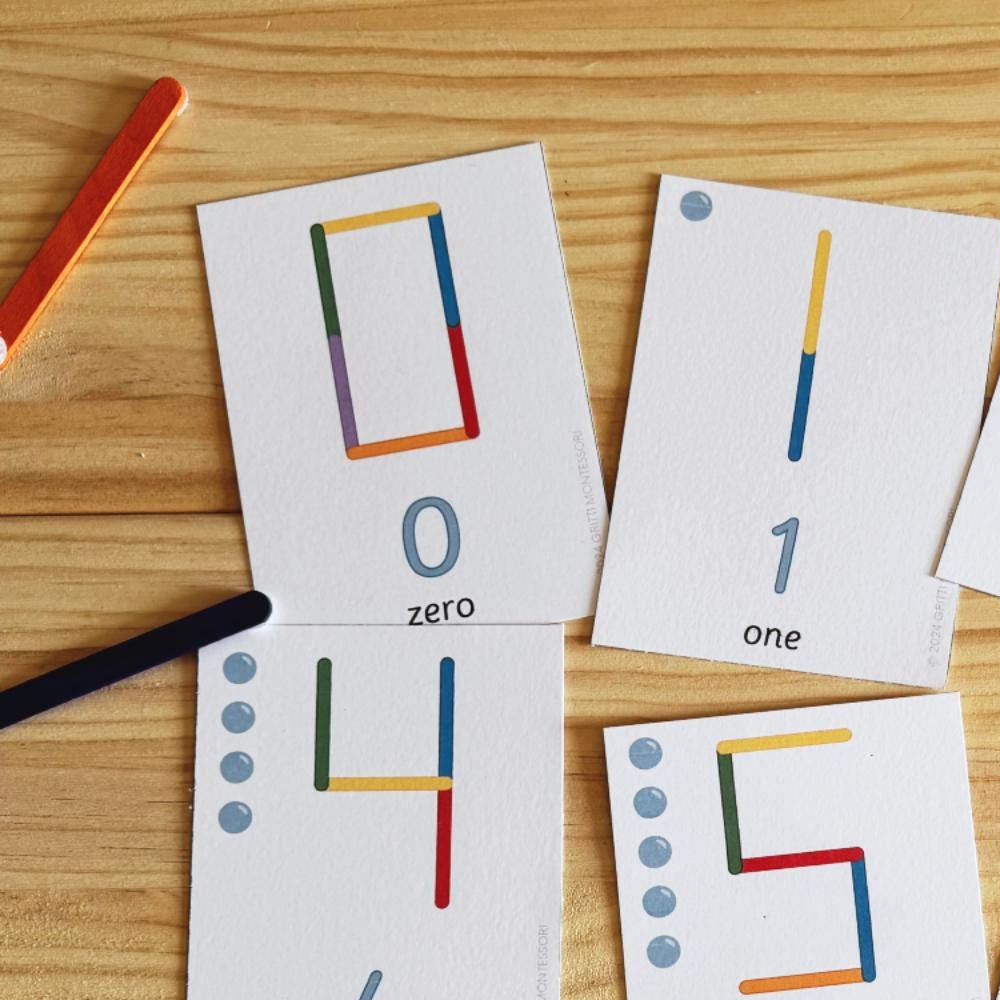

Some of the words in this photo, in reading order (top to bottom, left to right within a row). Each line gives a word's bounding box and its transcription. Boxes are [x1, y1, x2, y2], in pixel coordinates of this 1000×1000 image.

[402, 496, 460, 580] 0
[772, 517, 800, 595] 1
[407, 597, 475, 626] zero
[743, 623, 802, 651] one
